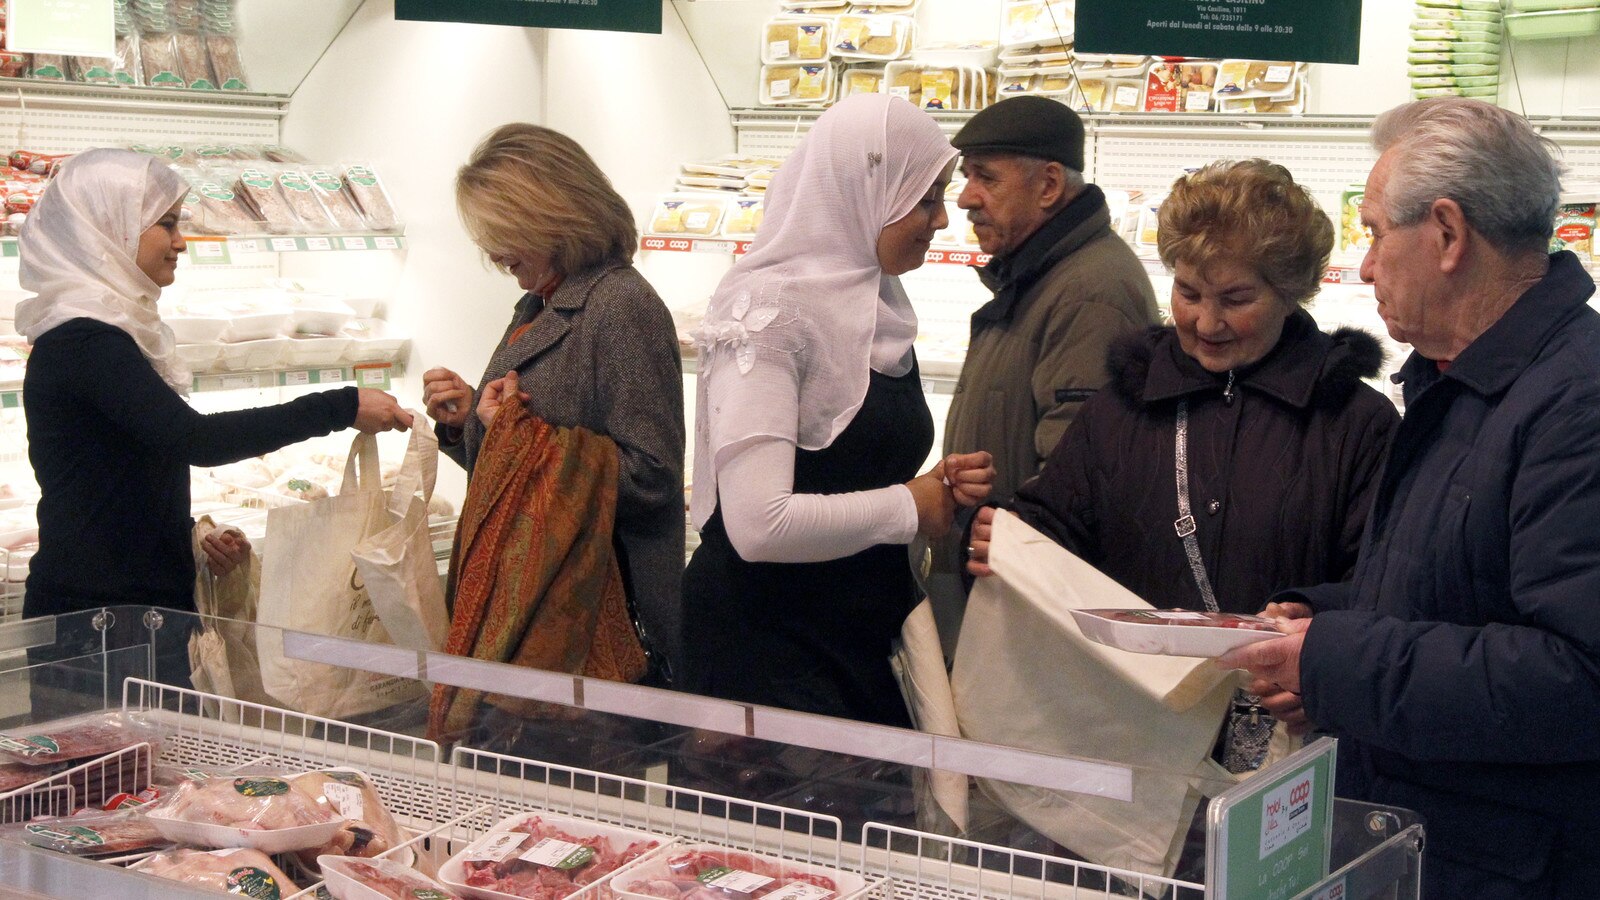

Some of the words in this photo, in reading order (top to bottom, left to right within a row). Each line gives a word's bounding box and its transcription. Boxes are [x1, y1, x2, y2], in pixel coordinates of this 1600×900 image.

[1211, 13, 1243, 21] 06/235171
[1147, 20, 1168, 28] Aperti
[1169, 20, 1180, 28] dal
[1204, 22, 1211, 30] al
[1212, 23, 1235, 31] sabato
[1236, 24, 1252, 32] dalle
[1254, 24, 1259, 32] 9
[1260, 25, 1273, 33] alle
[1274, 26, 1294, 34] 20:30
[646, 240, 665, 249] coop
[669, 240, 689, 250] coop
[949, 253, 971, 263] coop
[1290, 780, 1310, 806] coop
